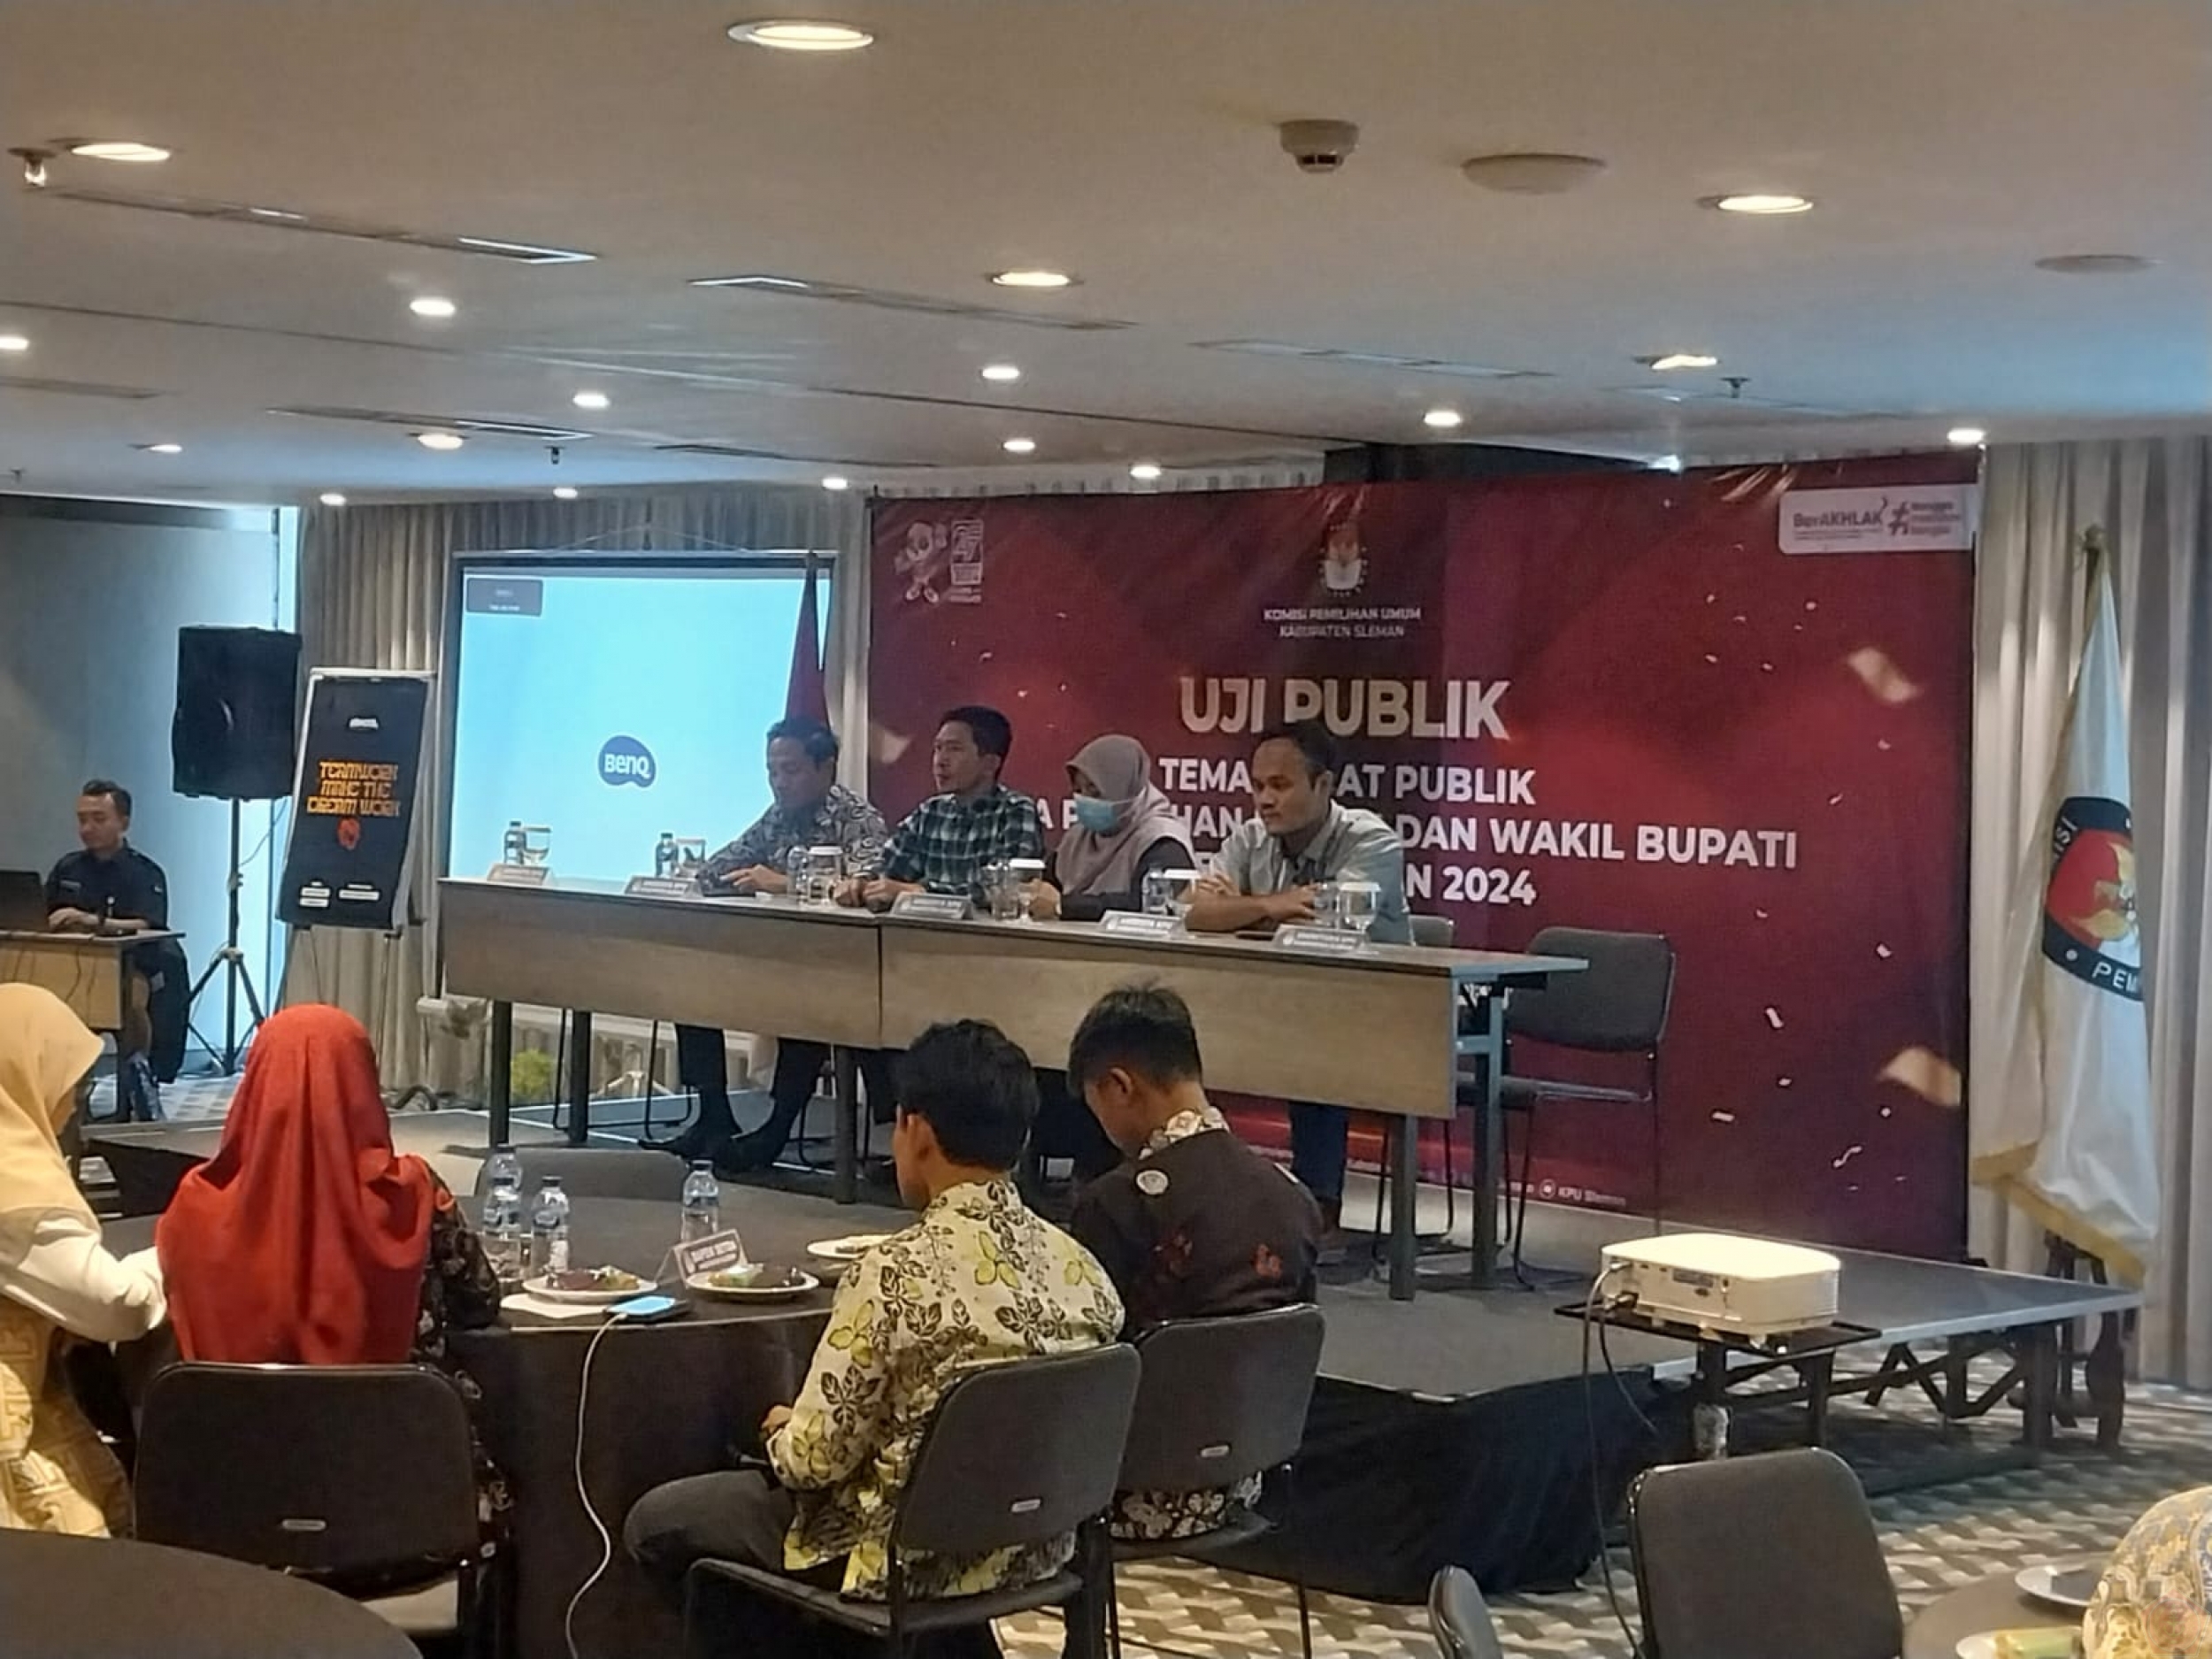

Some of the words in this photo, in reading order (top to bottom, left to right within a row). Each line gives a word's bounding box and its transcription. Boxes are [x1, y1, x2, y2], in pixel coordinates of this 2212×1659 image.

[1179, 677, 1266, 733] UJI
[1284, 678, 1510, 741] PUBLIK
[604, 753, 651, 779] BenQ
[1159, 758, 1252, 793] TEMA
[1394, 764, 1536, 805] PUBLIK
[1395, 814, 1478, 852] DAN
[1489, 818, 1624, 860] WAKIL
[1637, 826, 1797, 868] BUPATI
[1442, 866, 1537, 905] 2024
